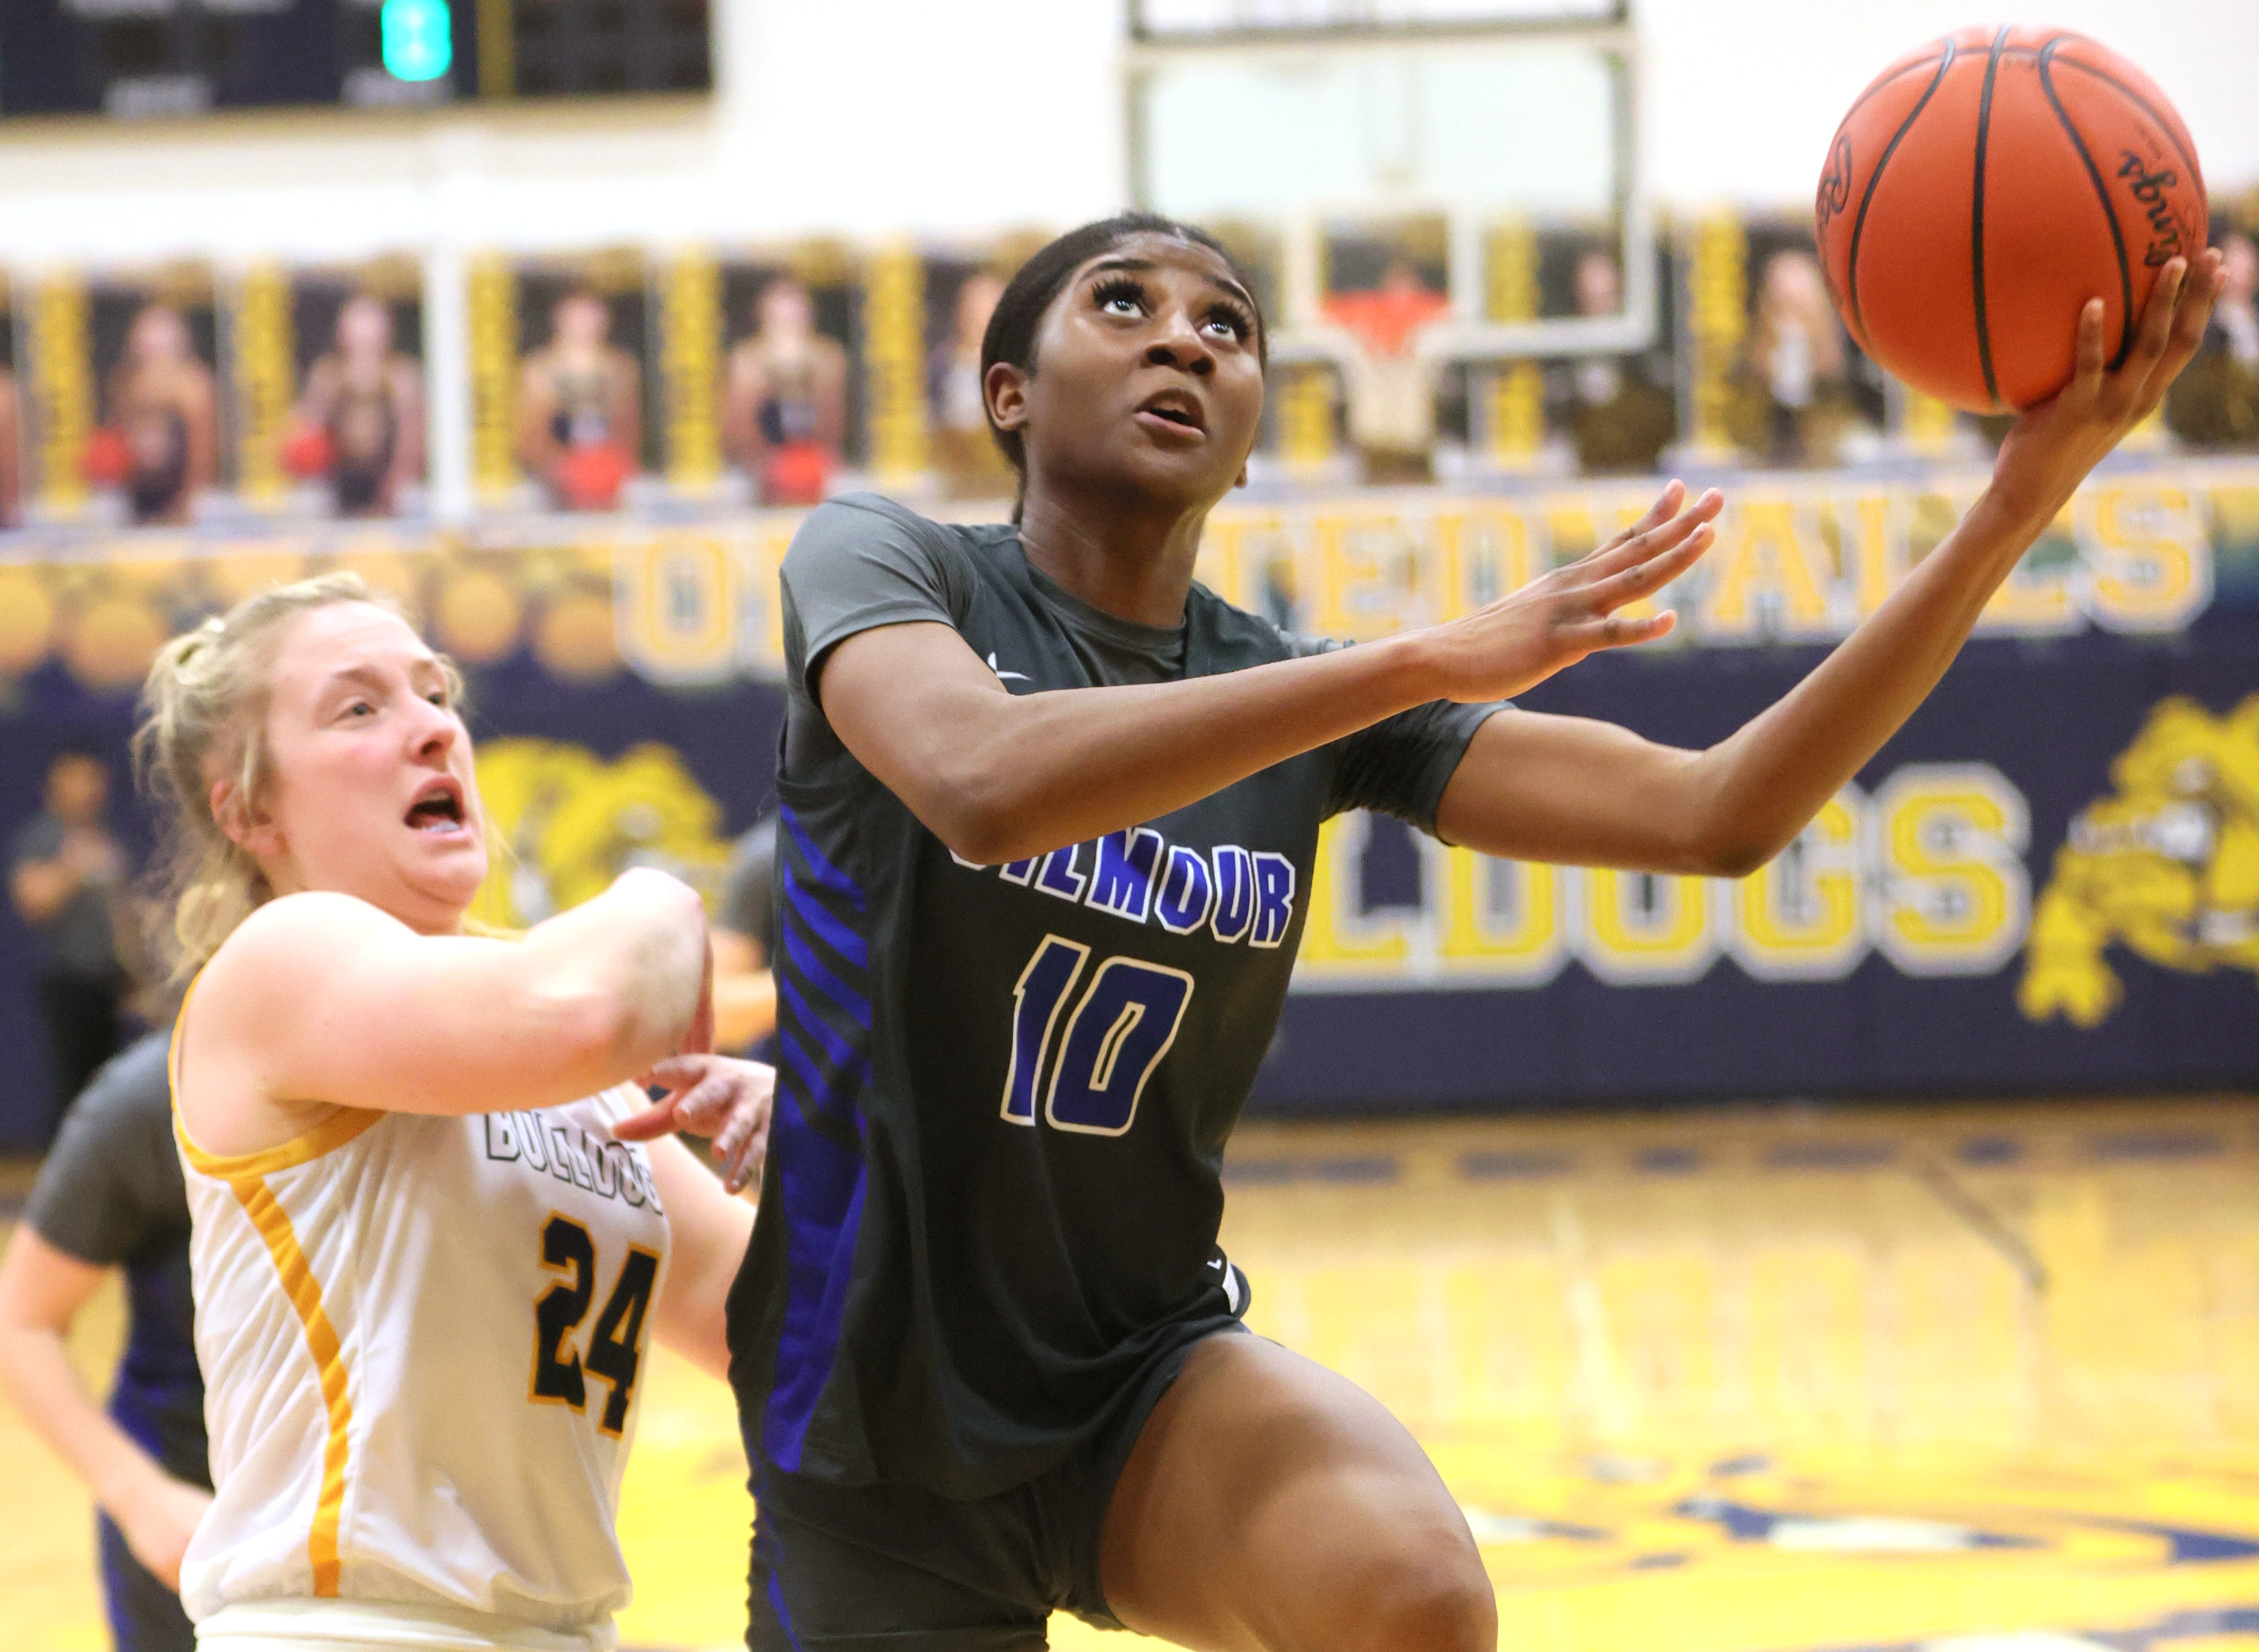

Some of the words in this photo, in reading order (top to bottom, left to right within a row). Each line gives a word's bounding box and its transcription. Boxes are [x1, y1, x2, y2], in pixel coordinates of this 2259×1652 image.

[950, 826, 1296, 949] LMOUR
[1000, 933, 1195, 1137] 10
[527, 1209, 662, 1440] 24
